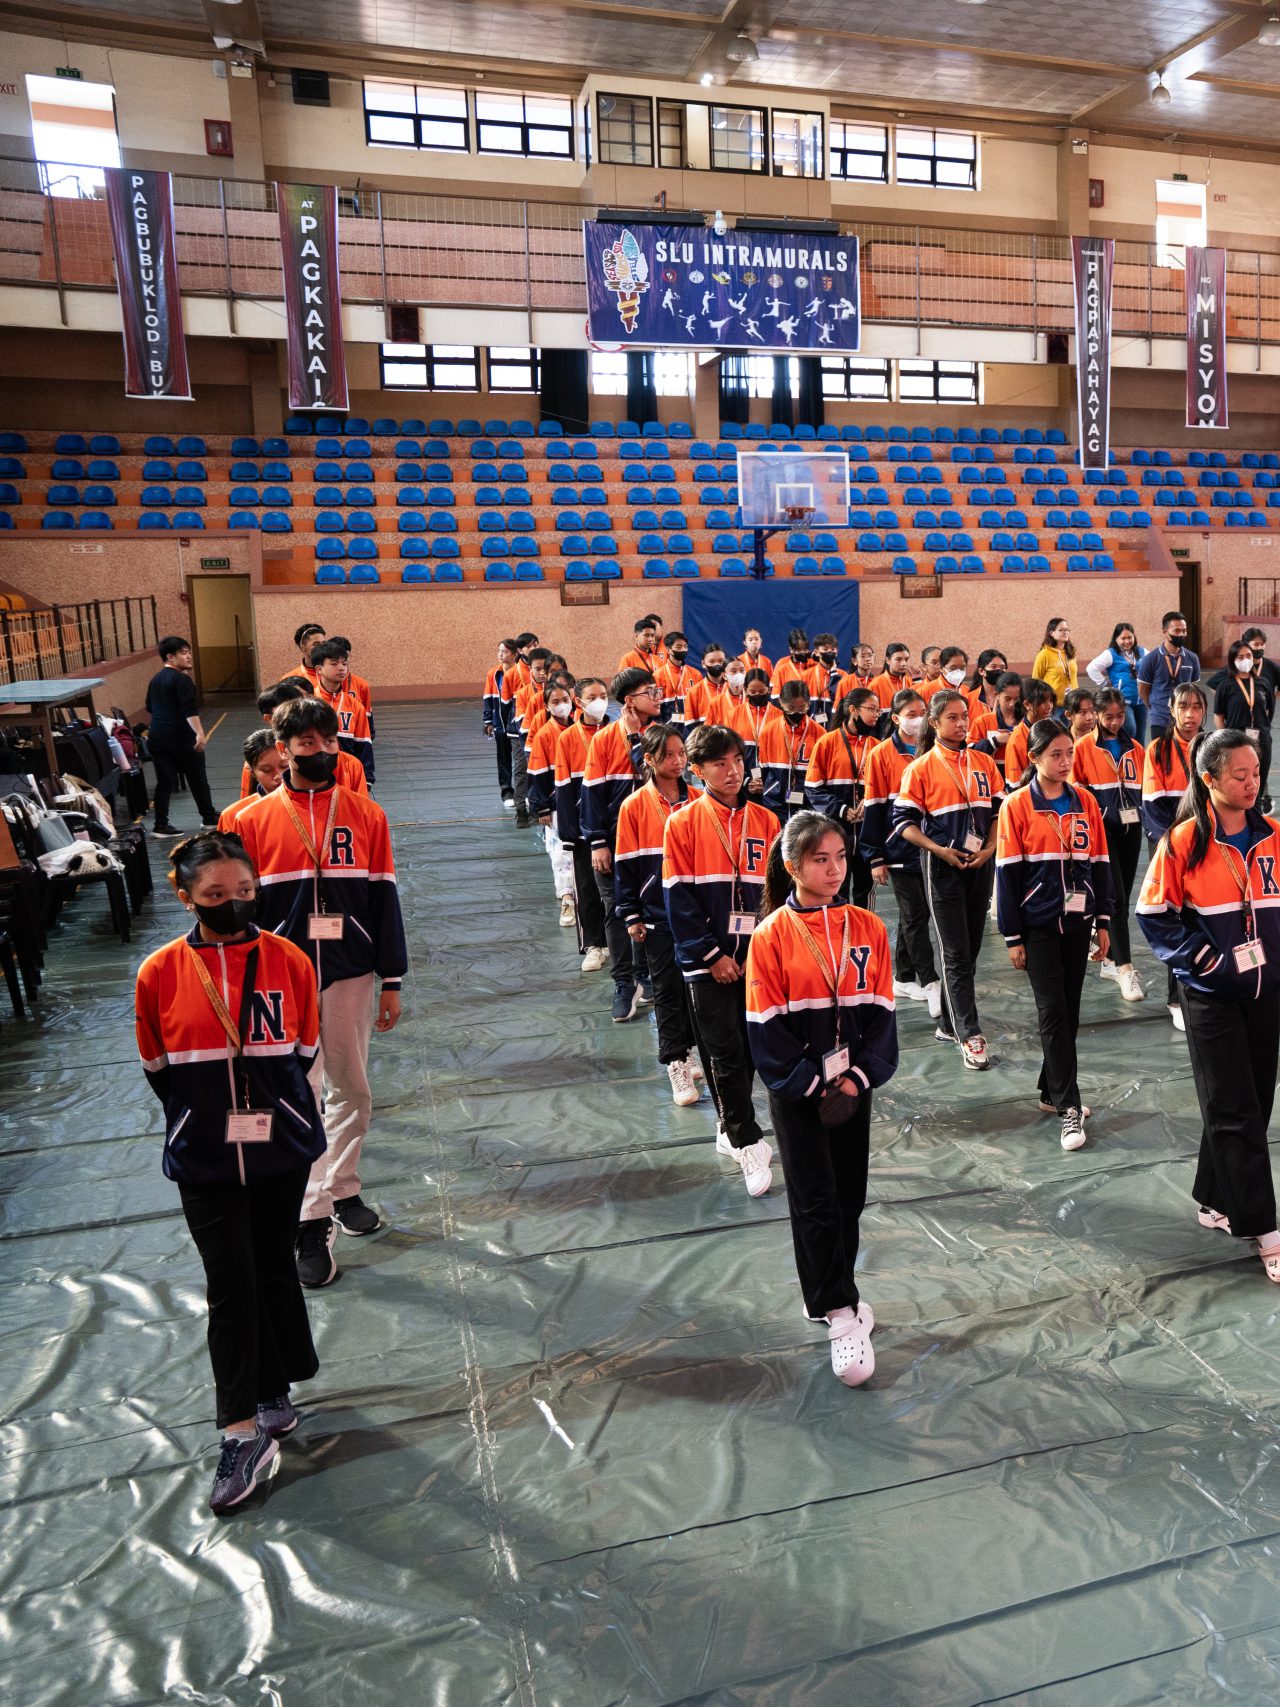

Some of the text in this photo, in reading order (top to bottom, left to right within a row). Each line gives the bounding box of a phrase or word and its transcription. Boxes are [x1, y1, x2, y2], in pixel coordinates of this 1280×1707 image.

[0, 84, 16, 95] XIT
[301, 200, 314, 209] AT
[655, 241, 694, 264] SLU
[703, 243, 848, 271] INTRAMURALS
[1200, 276, 1212, 284] NG
[1087, 261, 1100, 452] PAGPAPAHAYAG
[340, 711, 353, 731] V
[1124, 757, 1137, 781] D
[972, 771, 991, 798] H
[329, 826, 355, 866] R
[1073, 819, 1090, 850] S
[746, 837, 765, 872] F
[1256, 856, 1280, 896] K
[850, 945, 872, 991] Y
[251, 990, 286, 1042] N
